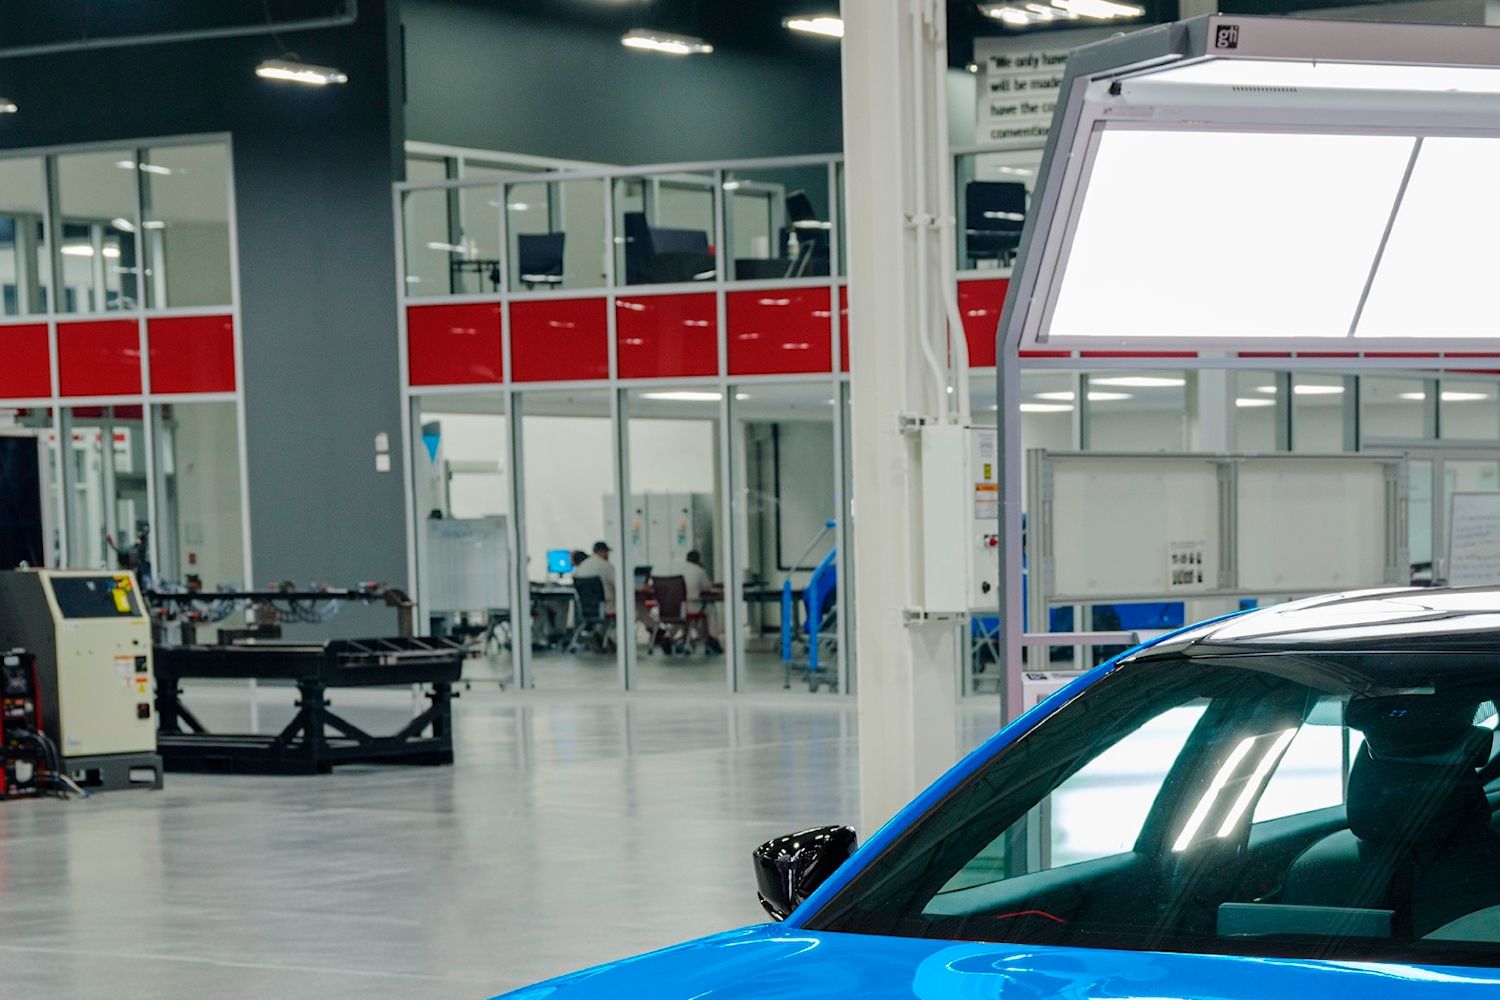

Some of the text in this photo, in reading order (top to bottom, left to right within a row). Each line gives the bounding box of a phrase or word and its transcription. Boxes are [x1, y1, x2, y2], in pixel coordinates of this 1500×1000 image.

[1015, 54, 1038, 68] only
[990, 80, 1010, 91] will
[1014, 79, 1026, 90] be
[990, 104, 1016, 115] have
[1021, 102, 1038, 113] the
